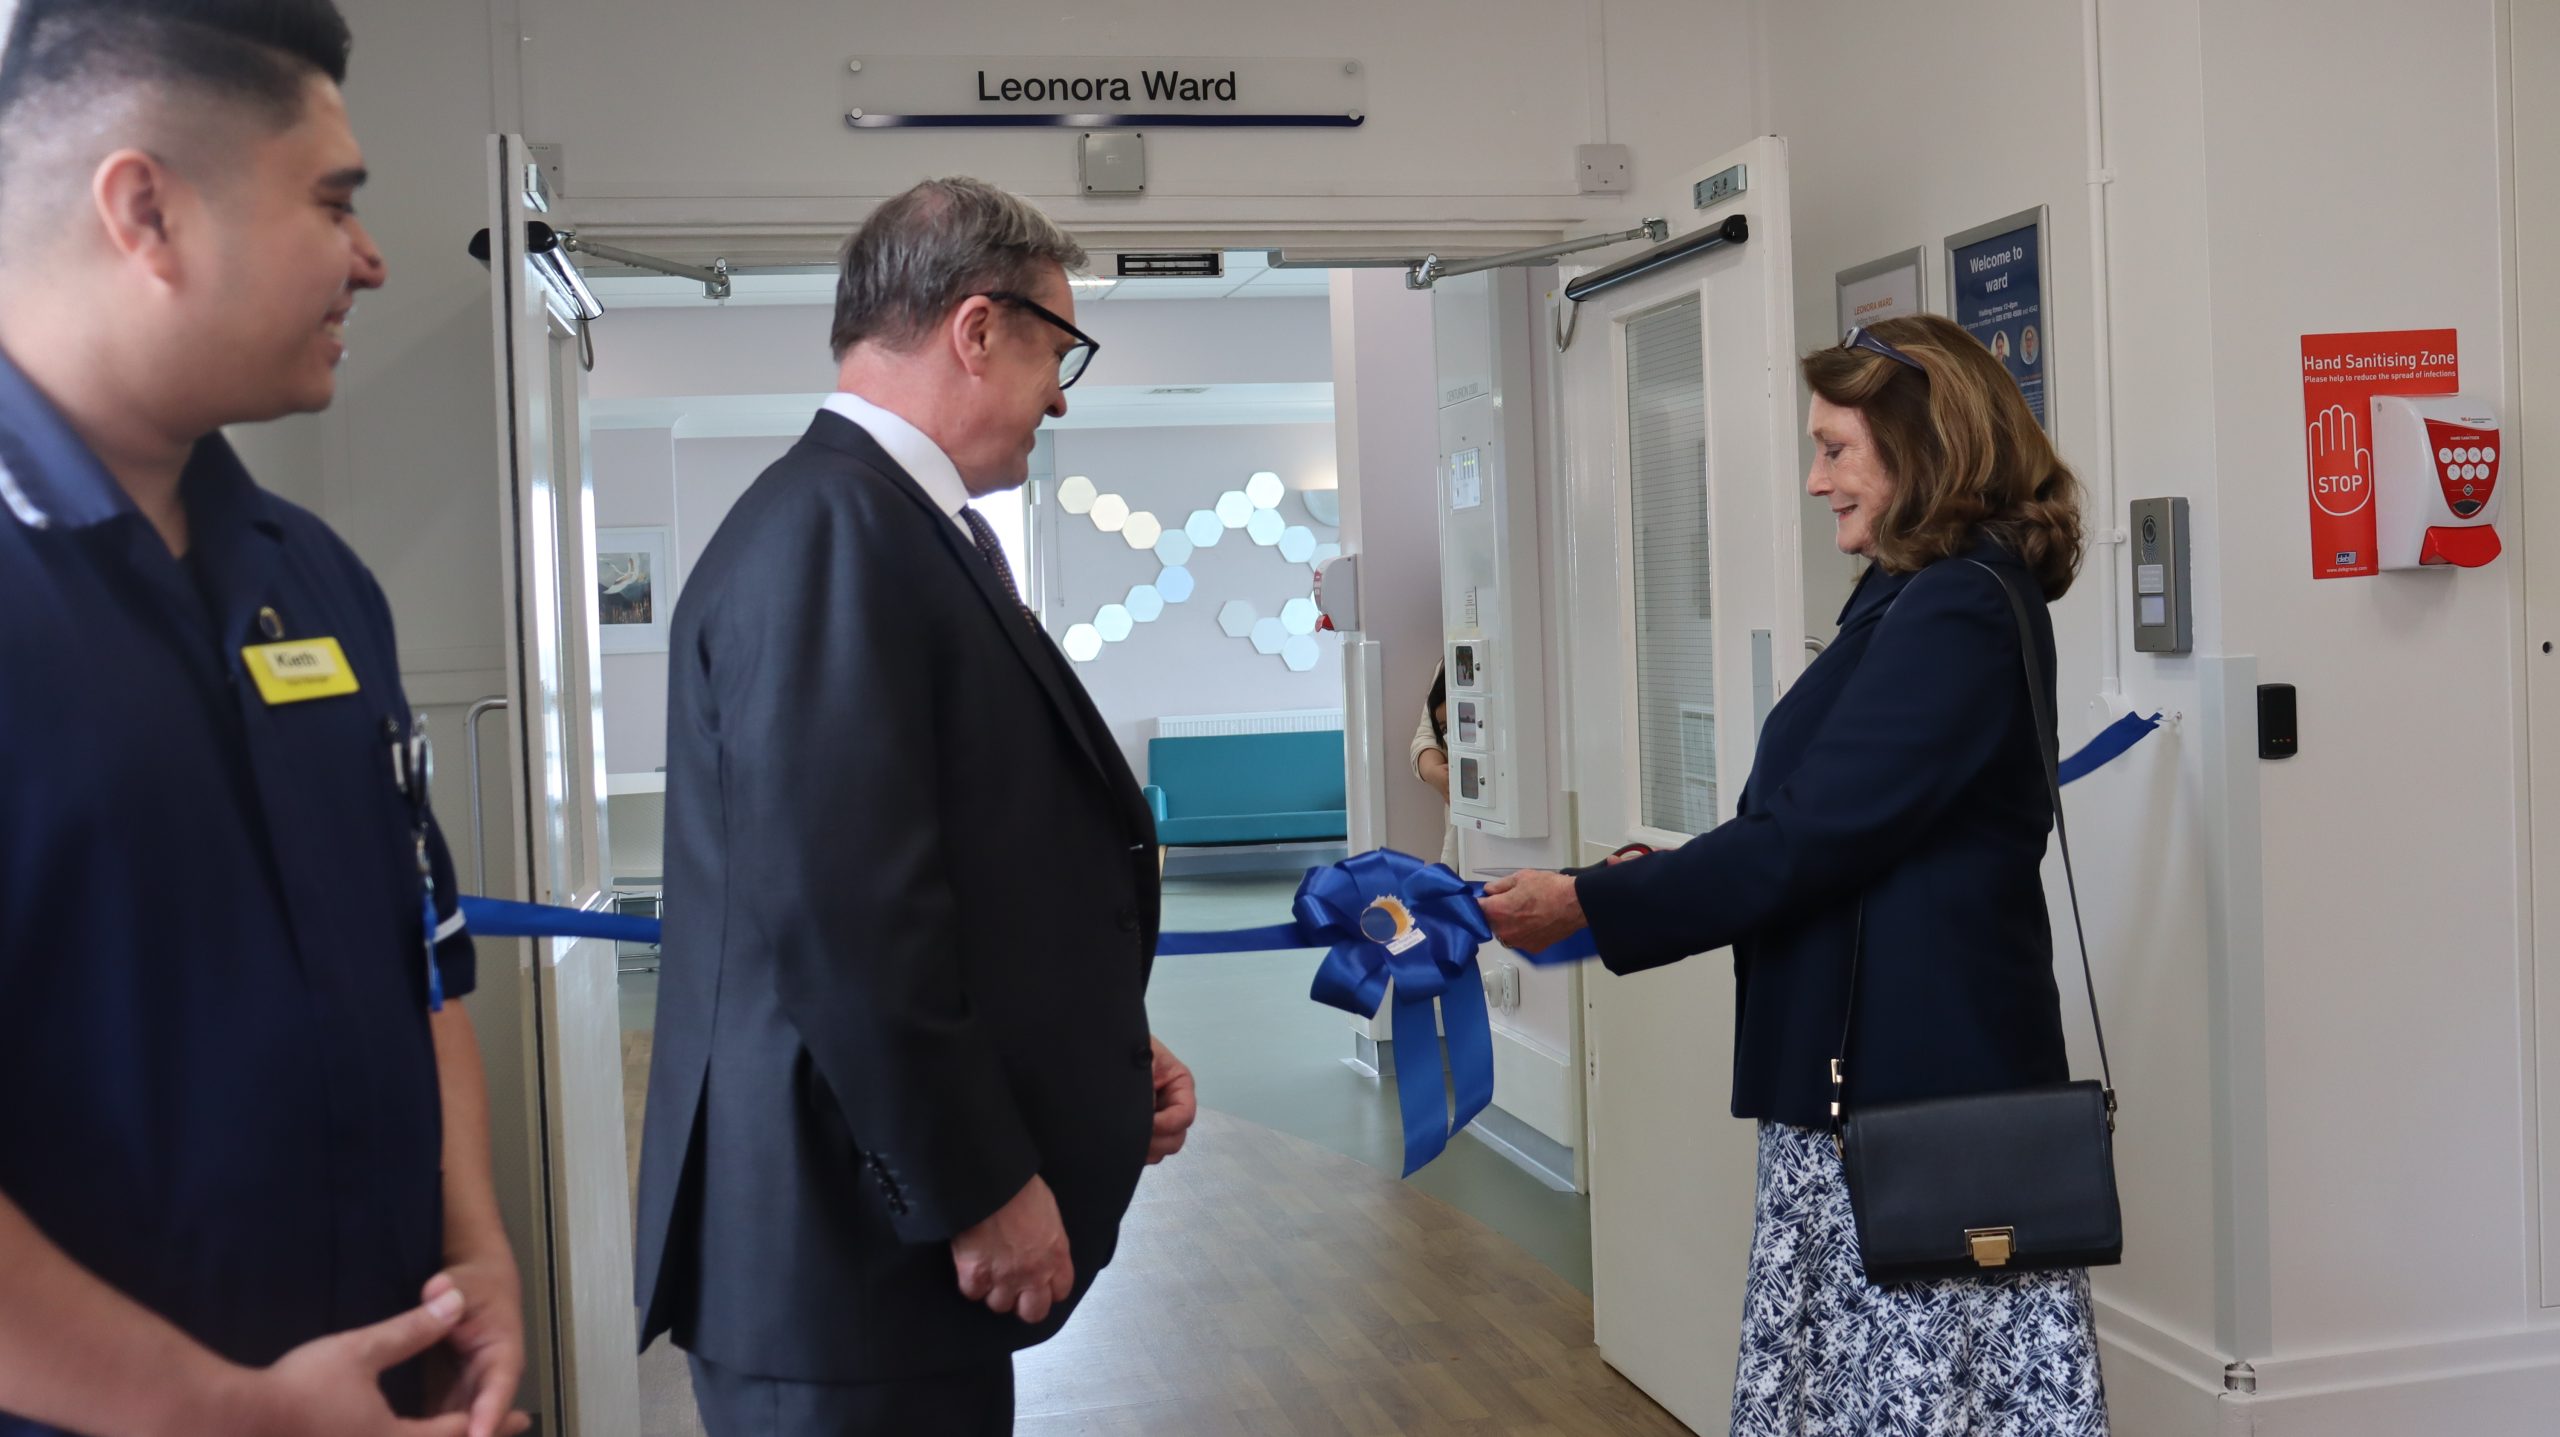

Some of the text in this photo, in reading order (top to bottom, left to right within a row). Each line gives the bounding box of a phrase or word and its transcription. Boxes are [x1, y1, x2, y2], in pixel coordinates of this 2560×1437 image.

[978, 71, 1236, 101] Leonora Ward
[1970, 246, 2023, 273] Welcome to
[1985, 272, 2008, 293] ward
[2304, 351, 2455, 371] Hand Sanitising Zone
[2304, 375, 2328, 383] Please
[2329, 374, 2345, 383] help
[2353, 373, 2377, 381] reduce
[2378, 372, 2390, 380] the
[2391, 371, 2414, 381] spread
[2415, 371, 2422, 379] of
[2423, 369, 2456, 378] infections
[2318, 474, 2363, 493] STOP
